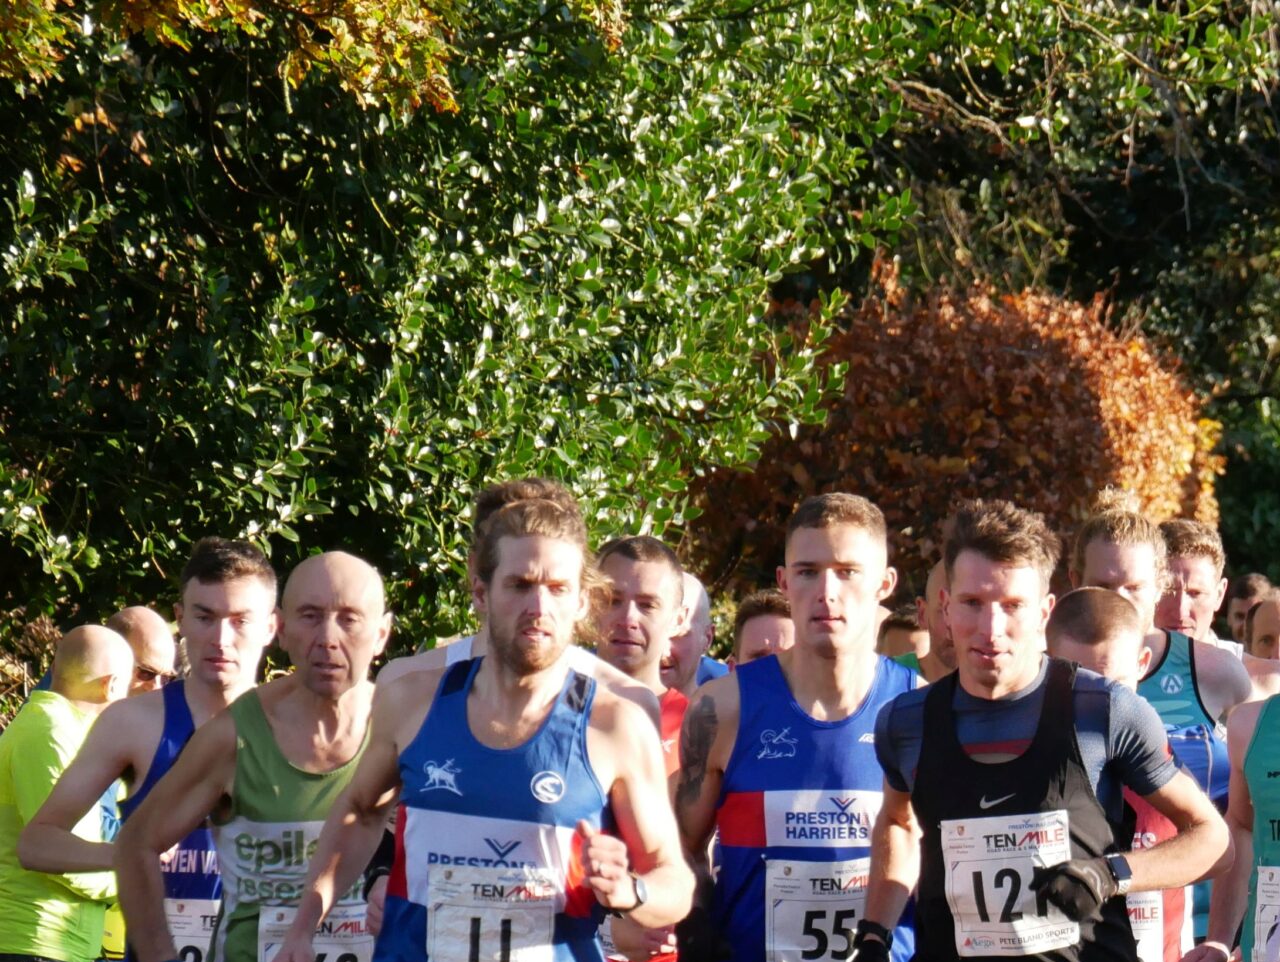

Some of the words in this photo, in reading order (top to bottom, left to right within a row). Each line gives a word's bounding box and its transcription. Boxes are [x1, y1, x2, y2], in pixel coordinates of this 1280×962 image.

[785, 811, 861, 825] PRESTON
[786, 827, 868, 840] HARRIERS
[983, 832, 1018, 848] TEN
[1017, 828, 1065, 848] MILE
[200, 850, 221, 874] VA
[471, 882, 505, 899] TEN
[809, 878, 842, 892] TEN
[842, 874, 869, 891] MI
[200, 915, 217, 928] TE
[333, 921, 370, 934] MIL
[801, 908, 856, 961] 55
[999, 937, 1016, 946] PETE
[1017, 934, 1044, 945] BLAND
[1045, 927, 1075, 939] SPORTS
